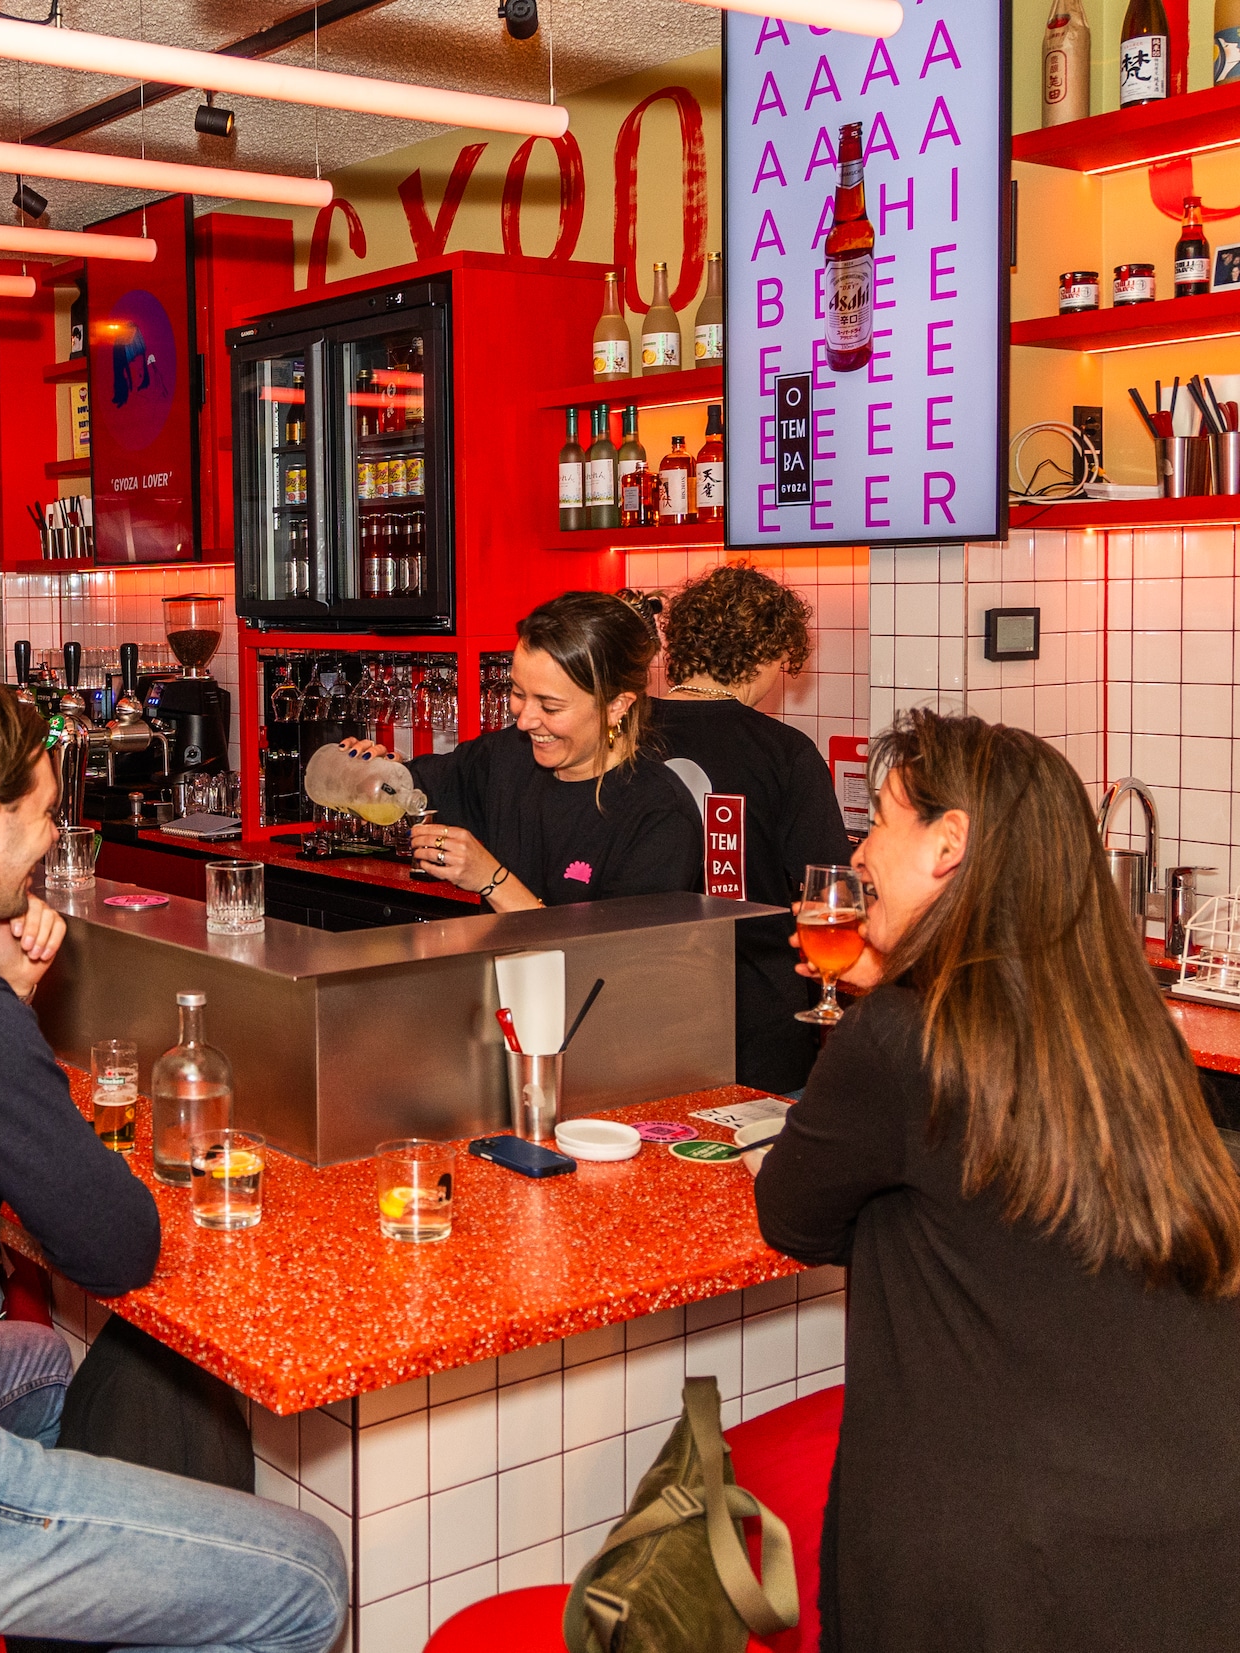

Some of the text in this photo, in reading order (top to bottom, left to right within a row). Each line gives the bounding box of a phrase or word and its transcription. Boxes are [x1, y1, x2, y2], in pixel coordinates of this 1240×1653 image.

[828, 282, 870, 312] Asahi
[785, 387, 802, 407] O
[780, 418, 806, 440] TEM
[783, 451, 805, 472] BA
[781, 483, 807, 494] GYOZA
[715, 806, 733, 823] O
[710, 833, 737, 850] TEM
[712, 860, 736, 875] BA
[711, 884, 739, 893] GYOZA
